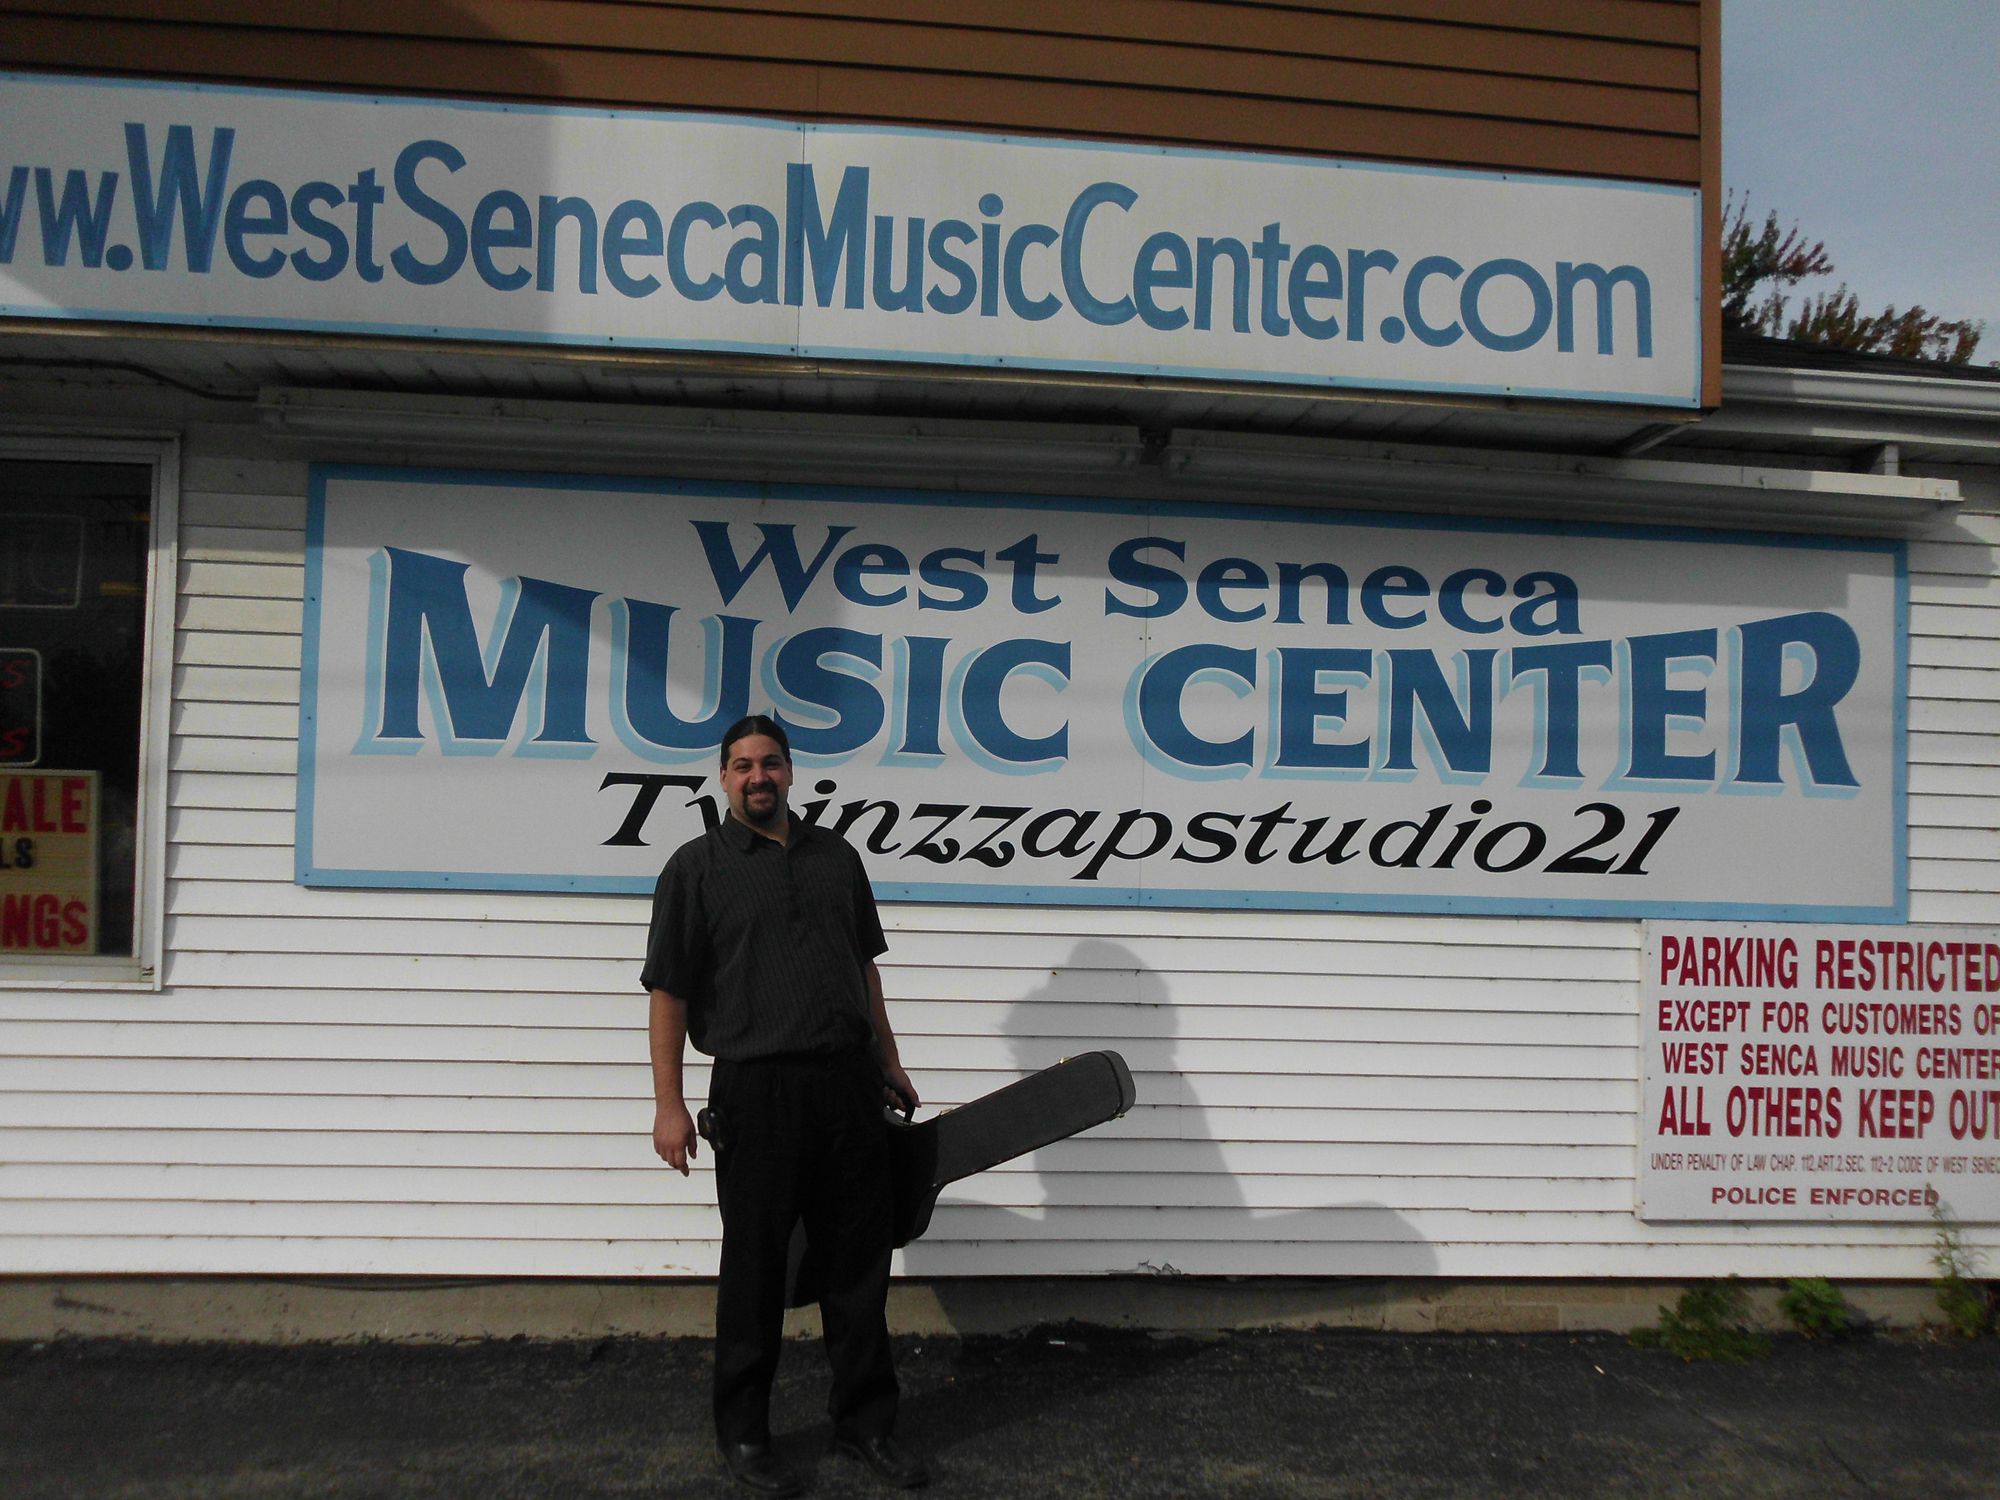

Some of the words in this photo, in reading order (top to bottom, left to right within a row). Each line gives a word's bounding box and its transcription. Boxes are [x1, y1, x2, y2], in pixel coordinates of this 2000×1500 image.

[689, 520, 1062, 614] West
[1104, 535, 1583, 635] Seneca
[350, 545, 1072, 774] MUSIC
[1122, 610, 1861, 799] CENTER
[1660, 935, 1798, 989] PARKING
[1815, 939, 2000, 992] RESTRICTED
[1658, 1000, 1750, 1032] EXCEPT
[1763, 1001, 1809, 1033] FOR
[1822, 1002, 1962, 1035] CUSTOMERS
[1974, 1003, 2000, 1036] OF
[1662, 1042, 1728, 1075] WEST
[1740, 1044, 1818, 1076] SENCA
[1831, 1045, 1904, 1078] MUSIC
[1916, 1047, 2000, 1080] CENTER
[1658, 1086, 1711, 1136] ALL
[1726, 1085, 1842, 1138] OTHERS
[1858, 1088, 1935, 1139] KEEP
[1949, 1089, 2000, 1140] OUT
[1651, 1153, 1683, 1171] UNDER
[1687, 1153, 1727, 1171] PENALTY
[1731, 1153, 1743, 1171] OF
[1747, 1154, 1767, 1171] LAW
[1897, 1155, 1922, 1173] CODE
[1927, 1156, 1939, 1173] OF
[1943, 1156, 1968, 1174] WEST
[1712, 1187, 1797, 1205] POLICE
[1810, 1188, 1940, 1206] ENFORCED
